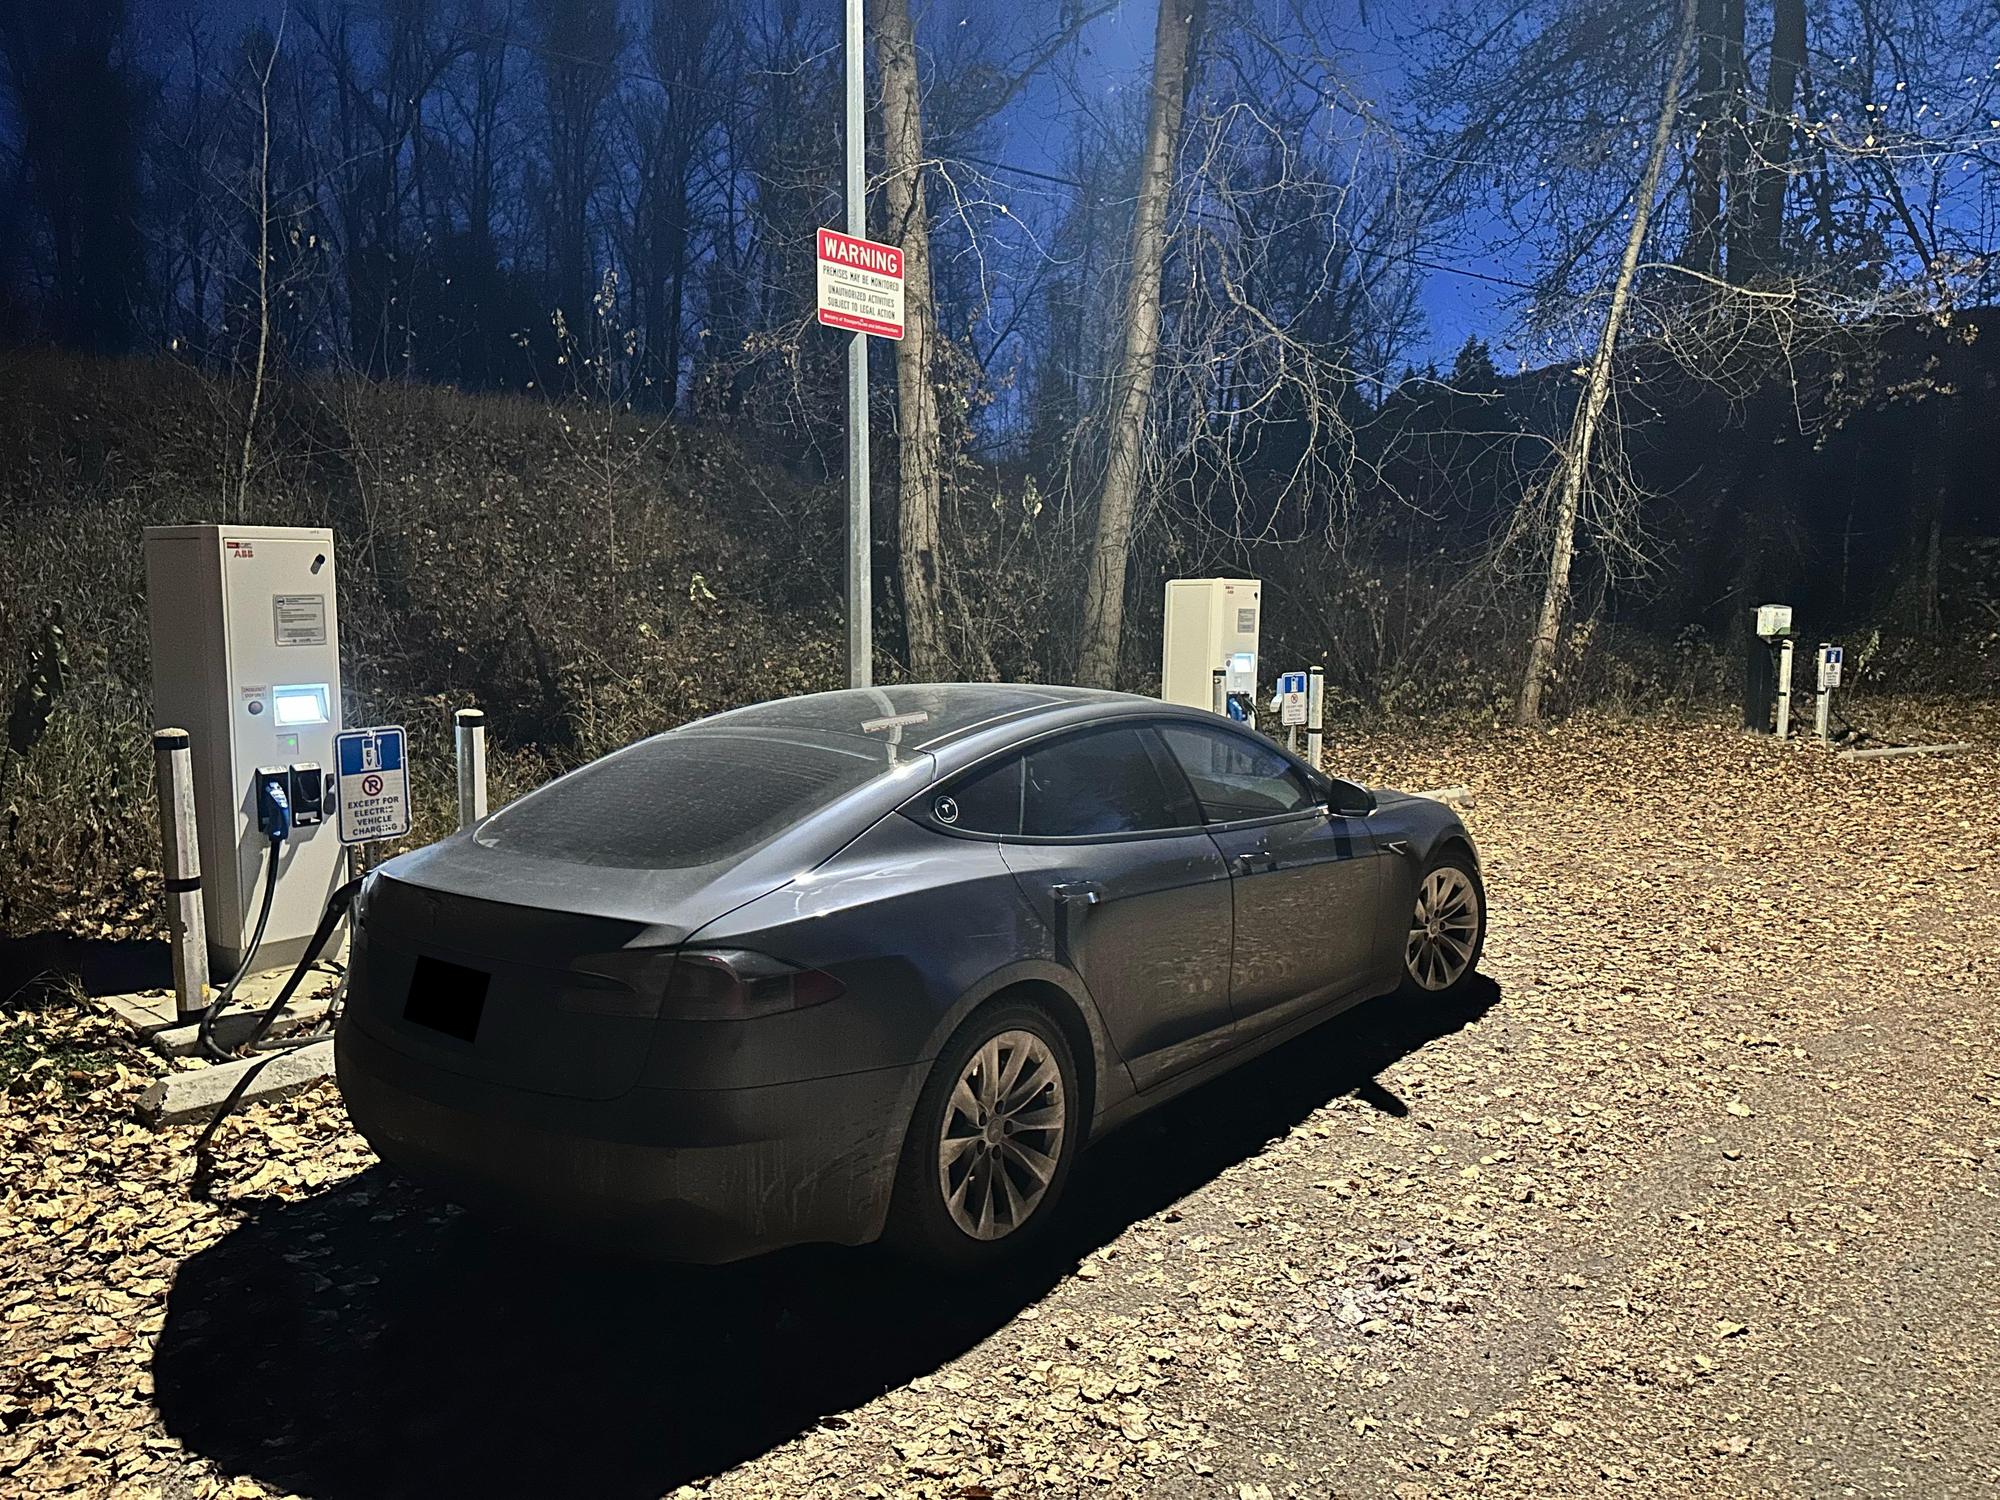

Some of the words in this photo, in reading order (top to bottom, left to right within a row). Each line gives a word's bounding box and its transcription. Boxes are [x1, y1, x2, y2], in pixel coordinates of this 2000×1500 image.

[825, 236, 897, 273] WARNING
[823, 265, 848, 280] PREMISES
[850, 272, 860, 282] MAY
[862, 274, 868, 284] BE
[871, 277, 899, 292] MONITORED
[828, 284, 866, 302] UNAUTHORIZED
[868, 294, 894, 308] ACTIVITIES
[828, 296, 850, 310] SUBJECT
[852, 302, 858, 312] TO
[860, 304, 876, 316] LEGAL
[878, 308, 895, 320] ACTION
[234, 550, 254, 558] ABB
[348, 799, 380, 809] EXCEPT
[354, 806, 394, 818] ELECTRIC
[357, 815, 392, 826] VEHICLE
[352, 823, 398, 836] CHARGING
